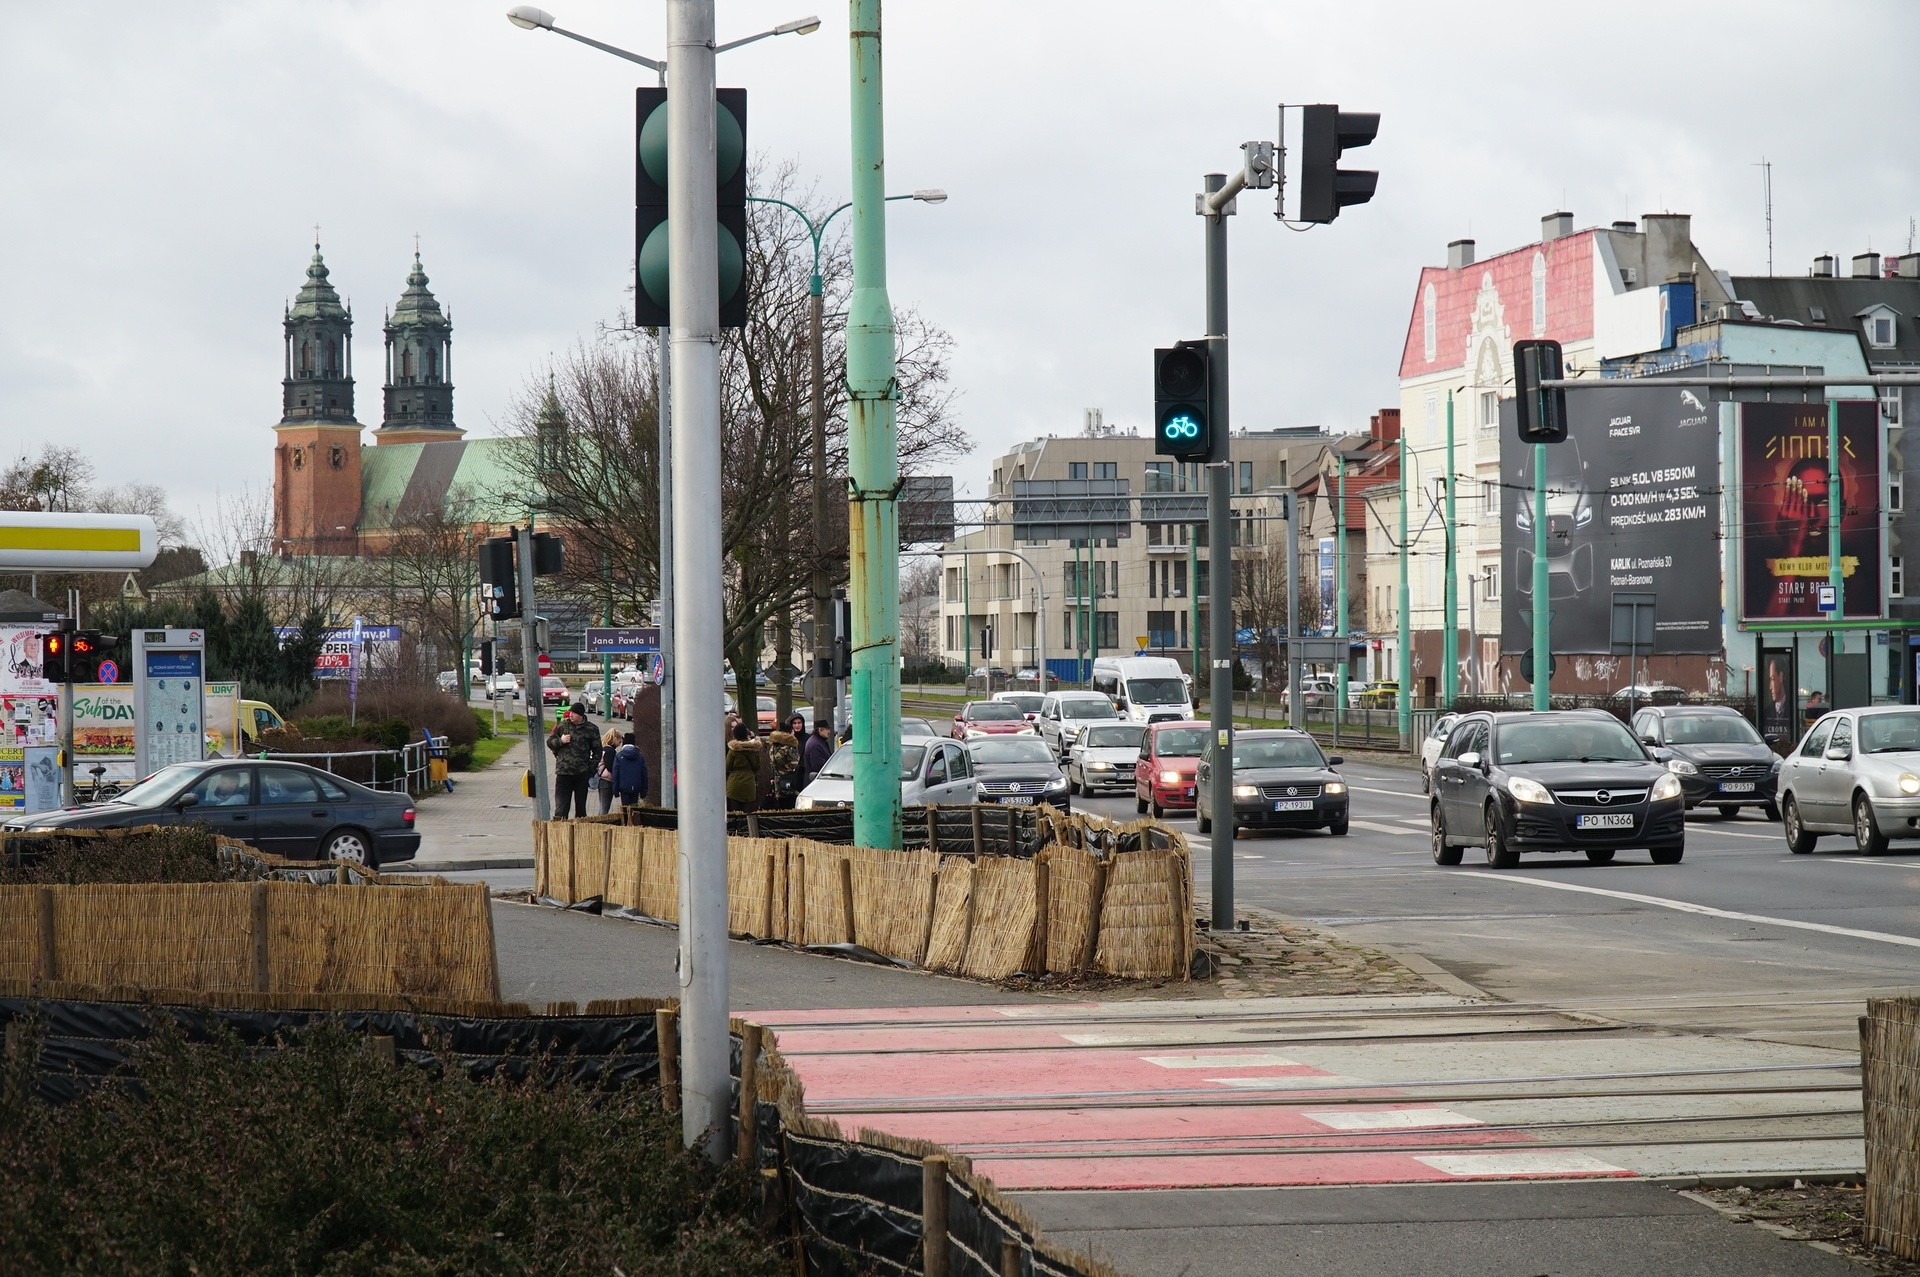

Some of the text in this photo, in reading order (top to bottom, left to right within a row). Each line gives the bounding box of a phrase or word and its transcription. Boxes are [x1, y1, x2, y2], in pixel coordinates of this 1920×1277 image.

[1609, 416, 1632, 426] JAGUAR
[1678, 416, 1708, 428] JAGUAR
[1802, 417, 1816, 427] AM
[1820, 417, 1826, 427] A
[1609, 426, 1641, 438] F-PACE SVR
[1610, 465, 1696, 488] SILNIK 5.0L V8 550 KM
[1610, 493, 1635, 507] 0-100
[1634, 490, 1658, 505] KM/H
[1666, 488, 1680, 503] 4,3
[1680, 485, 1700, 500] SEK.
[1610, 510, 1646, 528] PRĘDKOŚĆ
[1664, 508, 1681, 522] 283
[1682, 505, 1706, 520] KM/H
[1611, 557, 1631, 570] KARLIK
[1638, 556, 1665, 569] Poznańska
[1664, 556, 1673, 567] 30
[1779, 562, 1796, 571] NOWY
[1610, 574, 1653, 586] Poznań-Baranowo
[1778, 582, 1805, 594] STARY
[592, 636, 655, 645] Jana Pawła II
[73, 697, 102, 718] Sub
[1722, 783, 1733, 792] PO
[1279, 801, 1289, 810] PZ
[1583, 815, 1633, 826] PO 1N366
